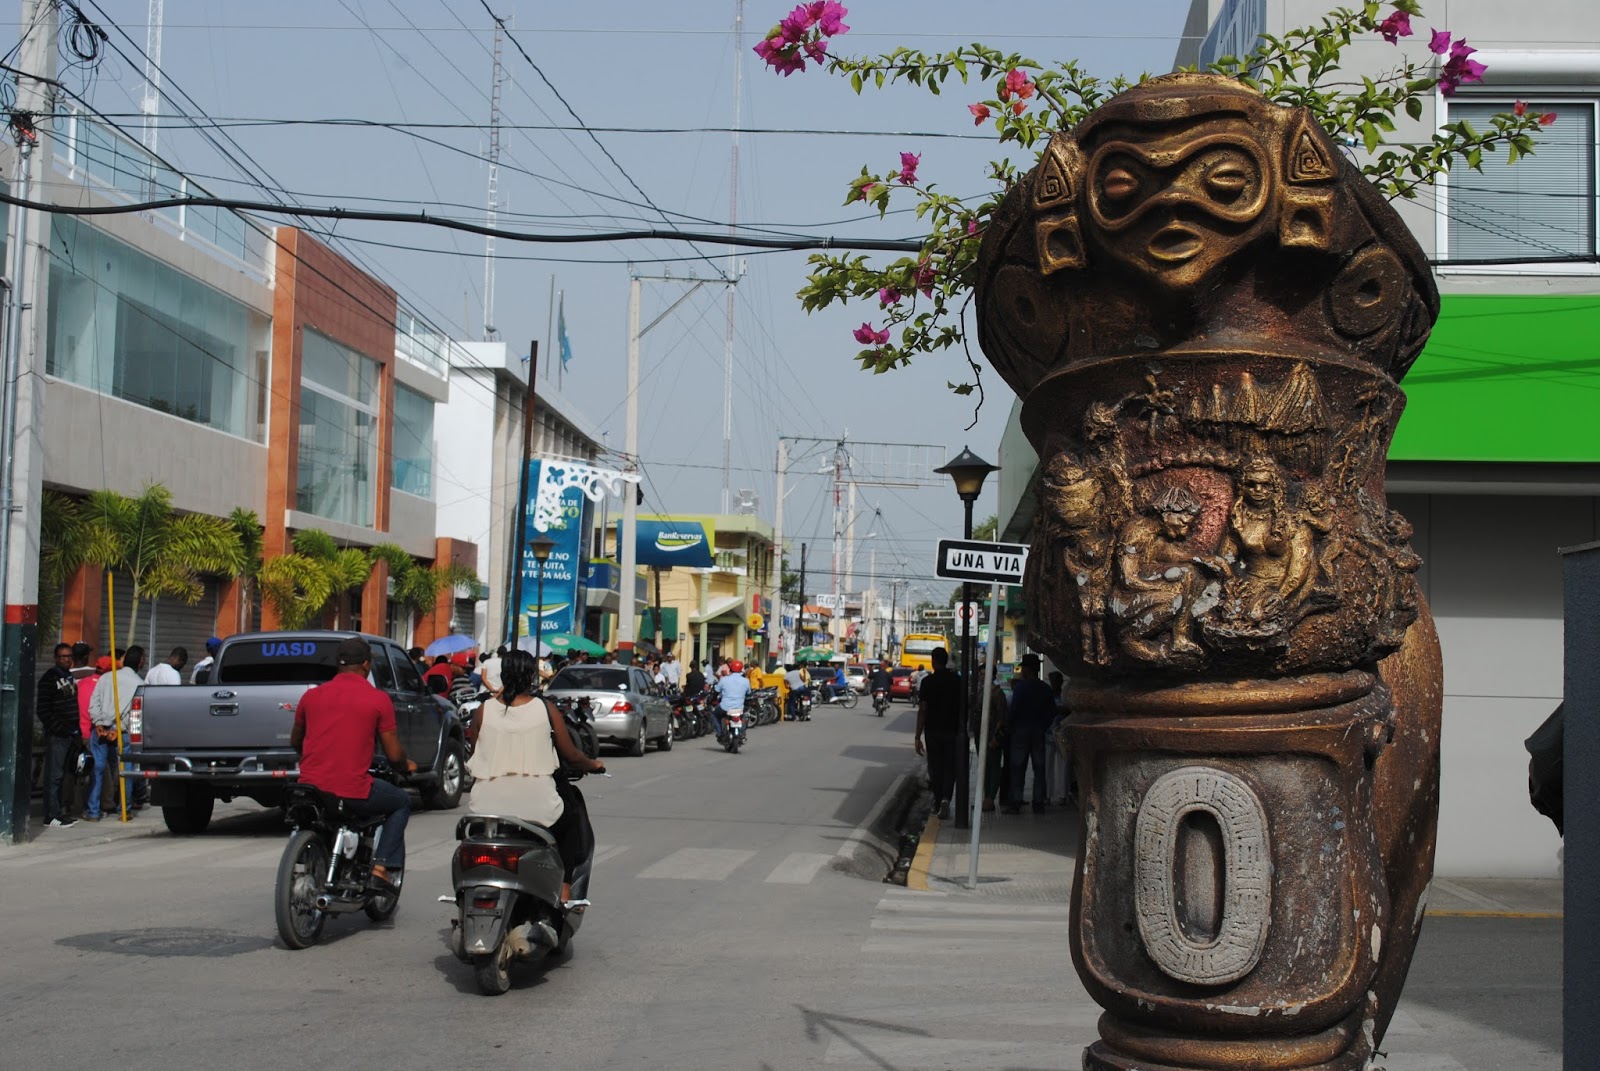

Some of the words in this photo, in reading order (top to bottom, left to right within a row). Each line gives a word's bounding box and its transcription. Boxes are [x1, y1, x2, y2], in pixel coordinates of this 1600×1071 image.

[658, 531, 702, 540] BanReservas
[523, 550, 534, 558] LA
[555, 552, 570, 560] NO
[952, 552, 984, 569] UNA
[994, 556, 1020, 572] VIA
[528, 570, 538, 578] TE
[553, 571, 571, 580] MÁS
[262, 642, 317, 657] UASD
